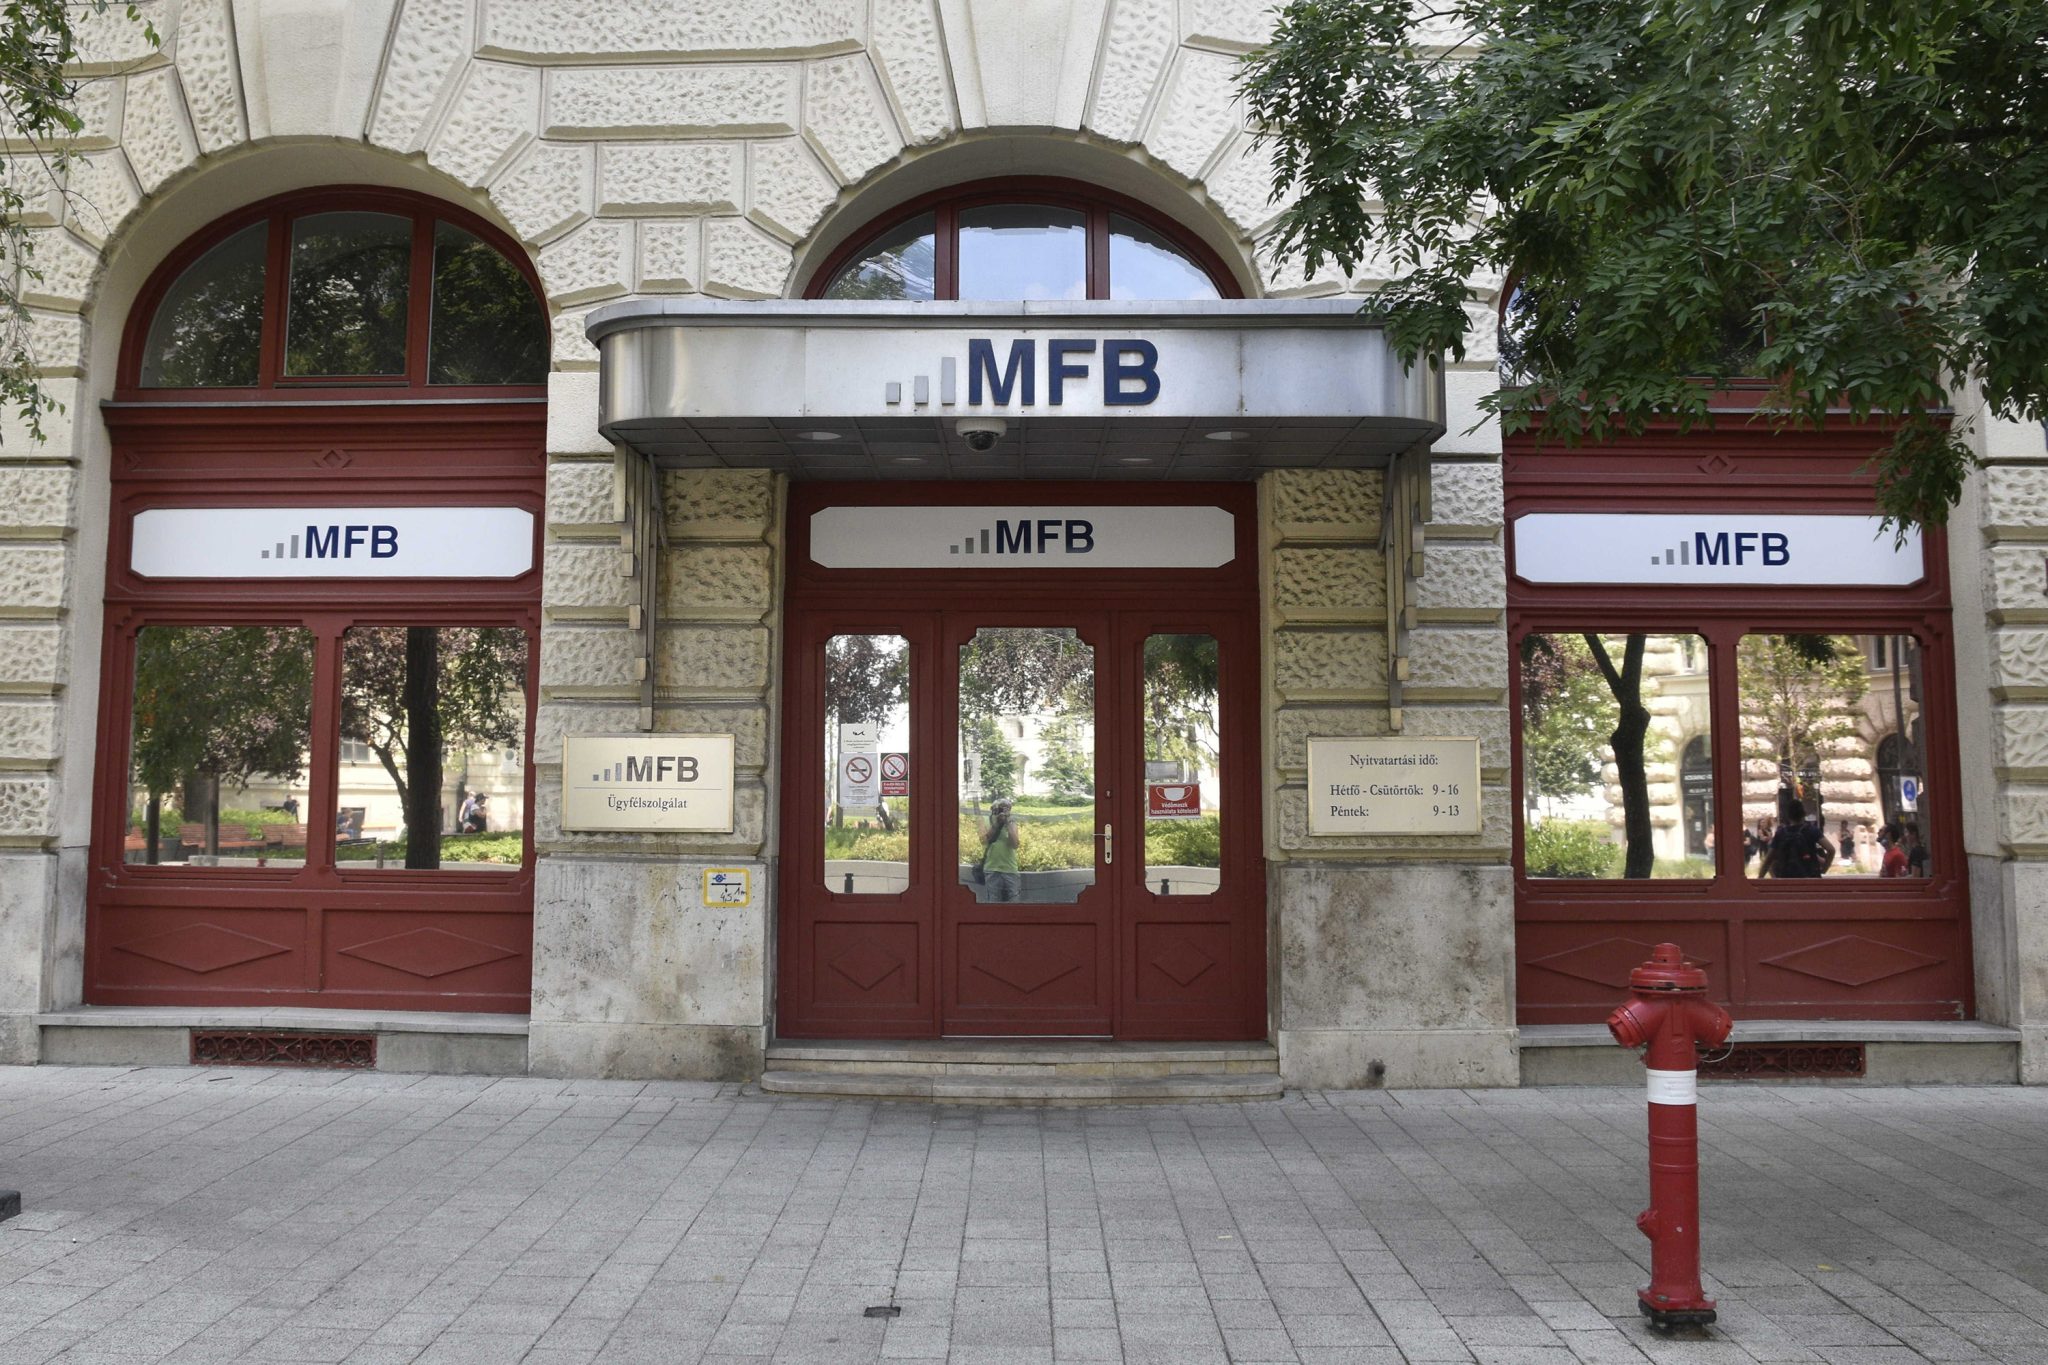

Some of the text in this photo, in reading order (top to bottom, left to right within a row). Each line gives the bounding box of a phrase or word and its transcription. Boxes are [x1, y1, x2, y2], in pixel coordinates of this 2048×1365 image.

[968, 338, 1161, 406] MFB
[305, 525, 399, 559] MFB
[996, 519, 1095, 554] MFB
[1695, 532, 1790, 566] MFB
[626, 755, 699, 782] MFB
[1350, 754, 1439, 768] Nyitvatartási idő:
[607, 793, 688, 812] Ügyfélszolgálat
[1330, 784, 1360, 796] Hétfő
[1369, 784, 1424, 796] Csütörtök:
[1432, 784, 1439, 795] 9
[1448, 784, 1459, 795] 16
[1330, 805, 1369, 817] Péntek:
[1433, 805, 1439, 816] 9
[1448, 805, 1460, 816] 13
